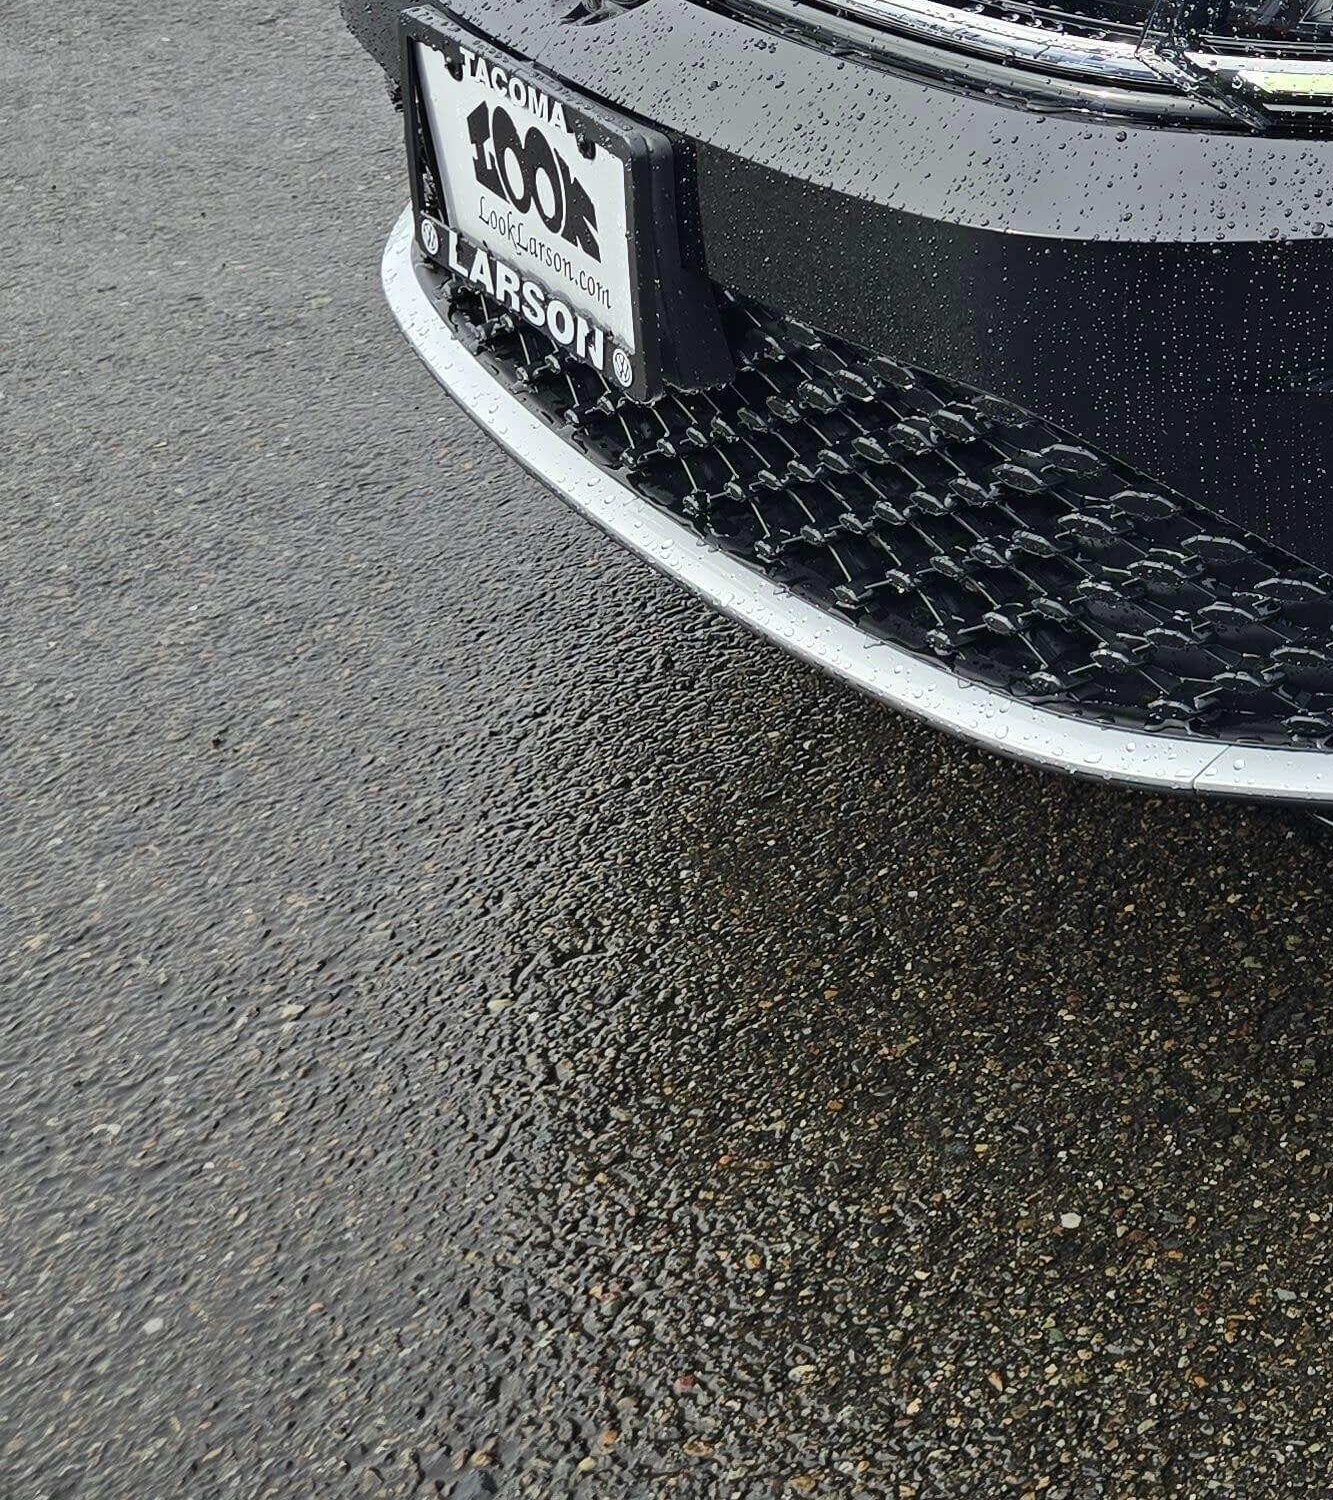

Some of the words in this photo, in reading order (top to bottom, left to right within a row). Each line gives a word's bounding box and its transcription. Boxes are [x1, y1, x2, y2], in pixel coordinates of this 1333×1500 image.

[459, 46, 569, 134] TACOMA
[467, 100, 602, 264] LOOK
[448, 232, 605, 370] LARSON
[479, 196, 612, 310] LookLarson.com
